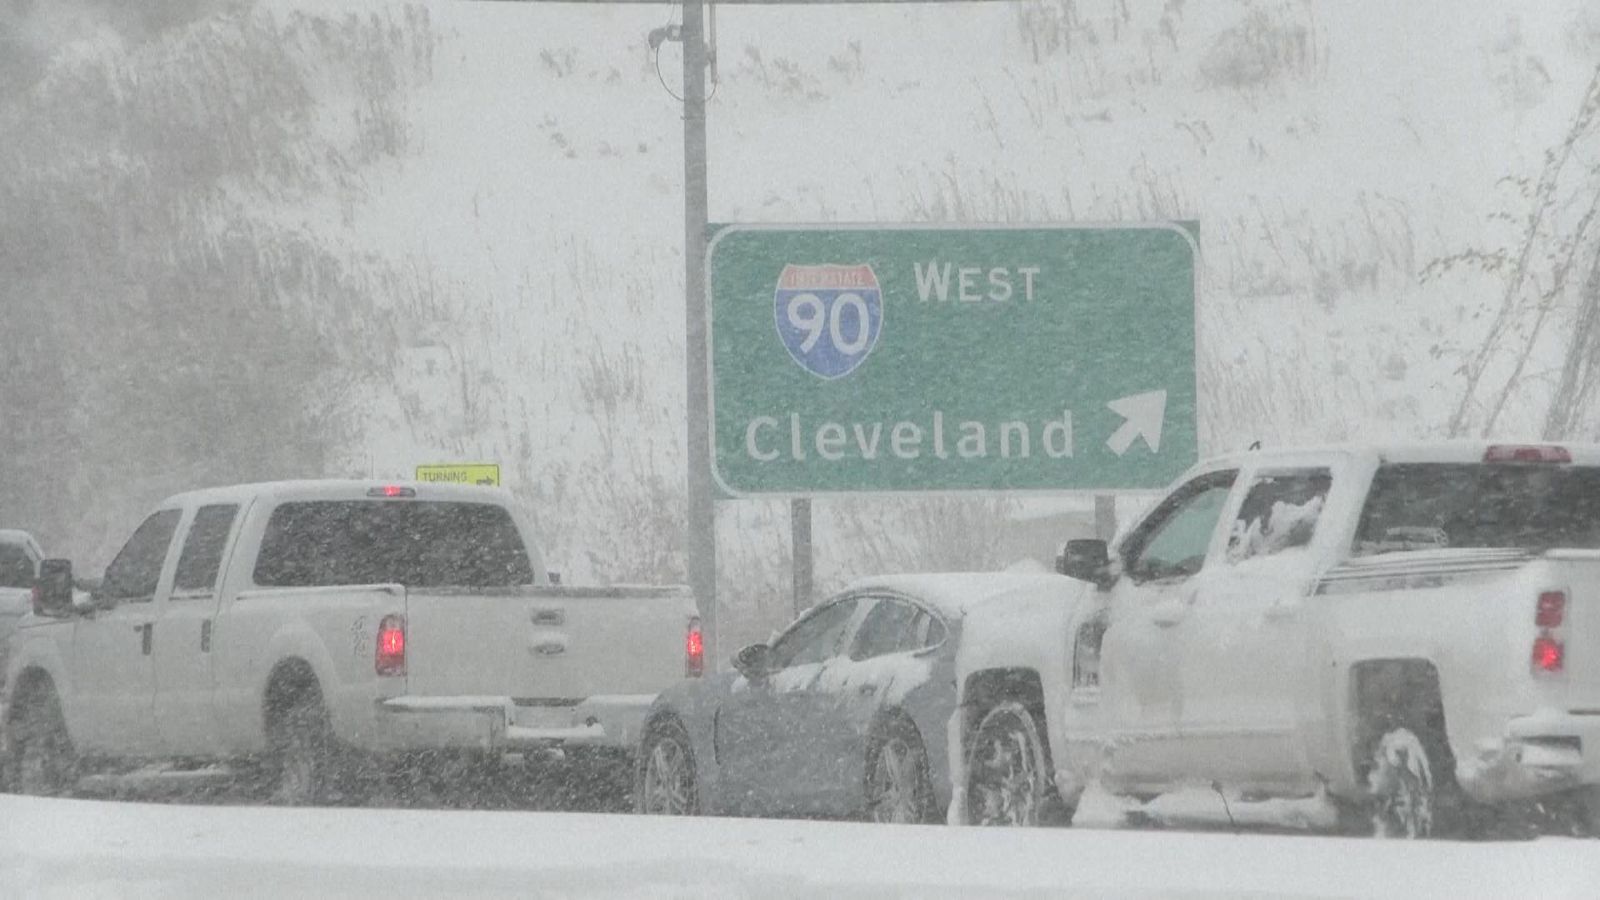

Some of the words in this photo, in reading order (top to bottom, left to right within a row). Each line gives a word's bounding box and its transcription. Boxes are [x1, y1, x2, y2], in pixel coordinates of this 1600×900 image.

[913, 259, 1041, 301] WEST
[787, 293, 870, 355] 90
[746, 410, 1074, 461] Cleveland
[422, 471, 468, 483] TURNING
